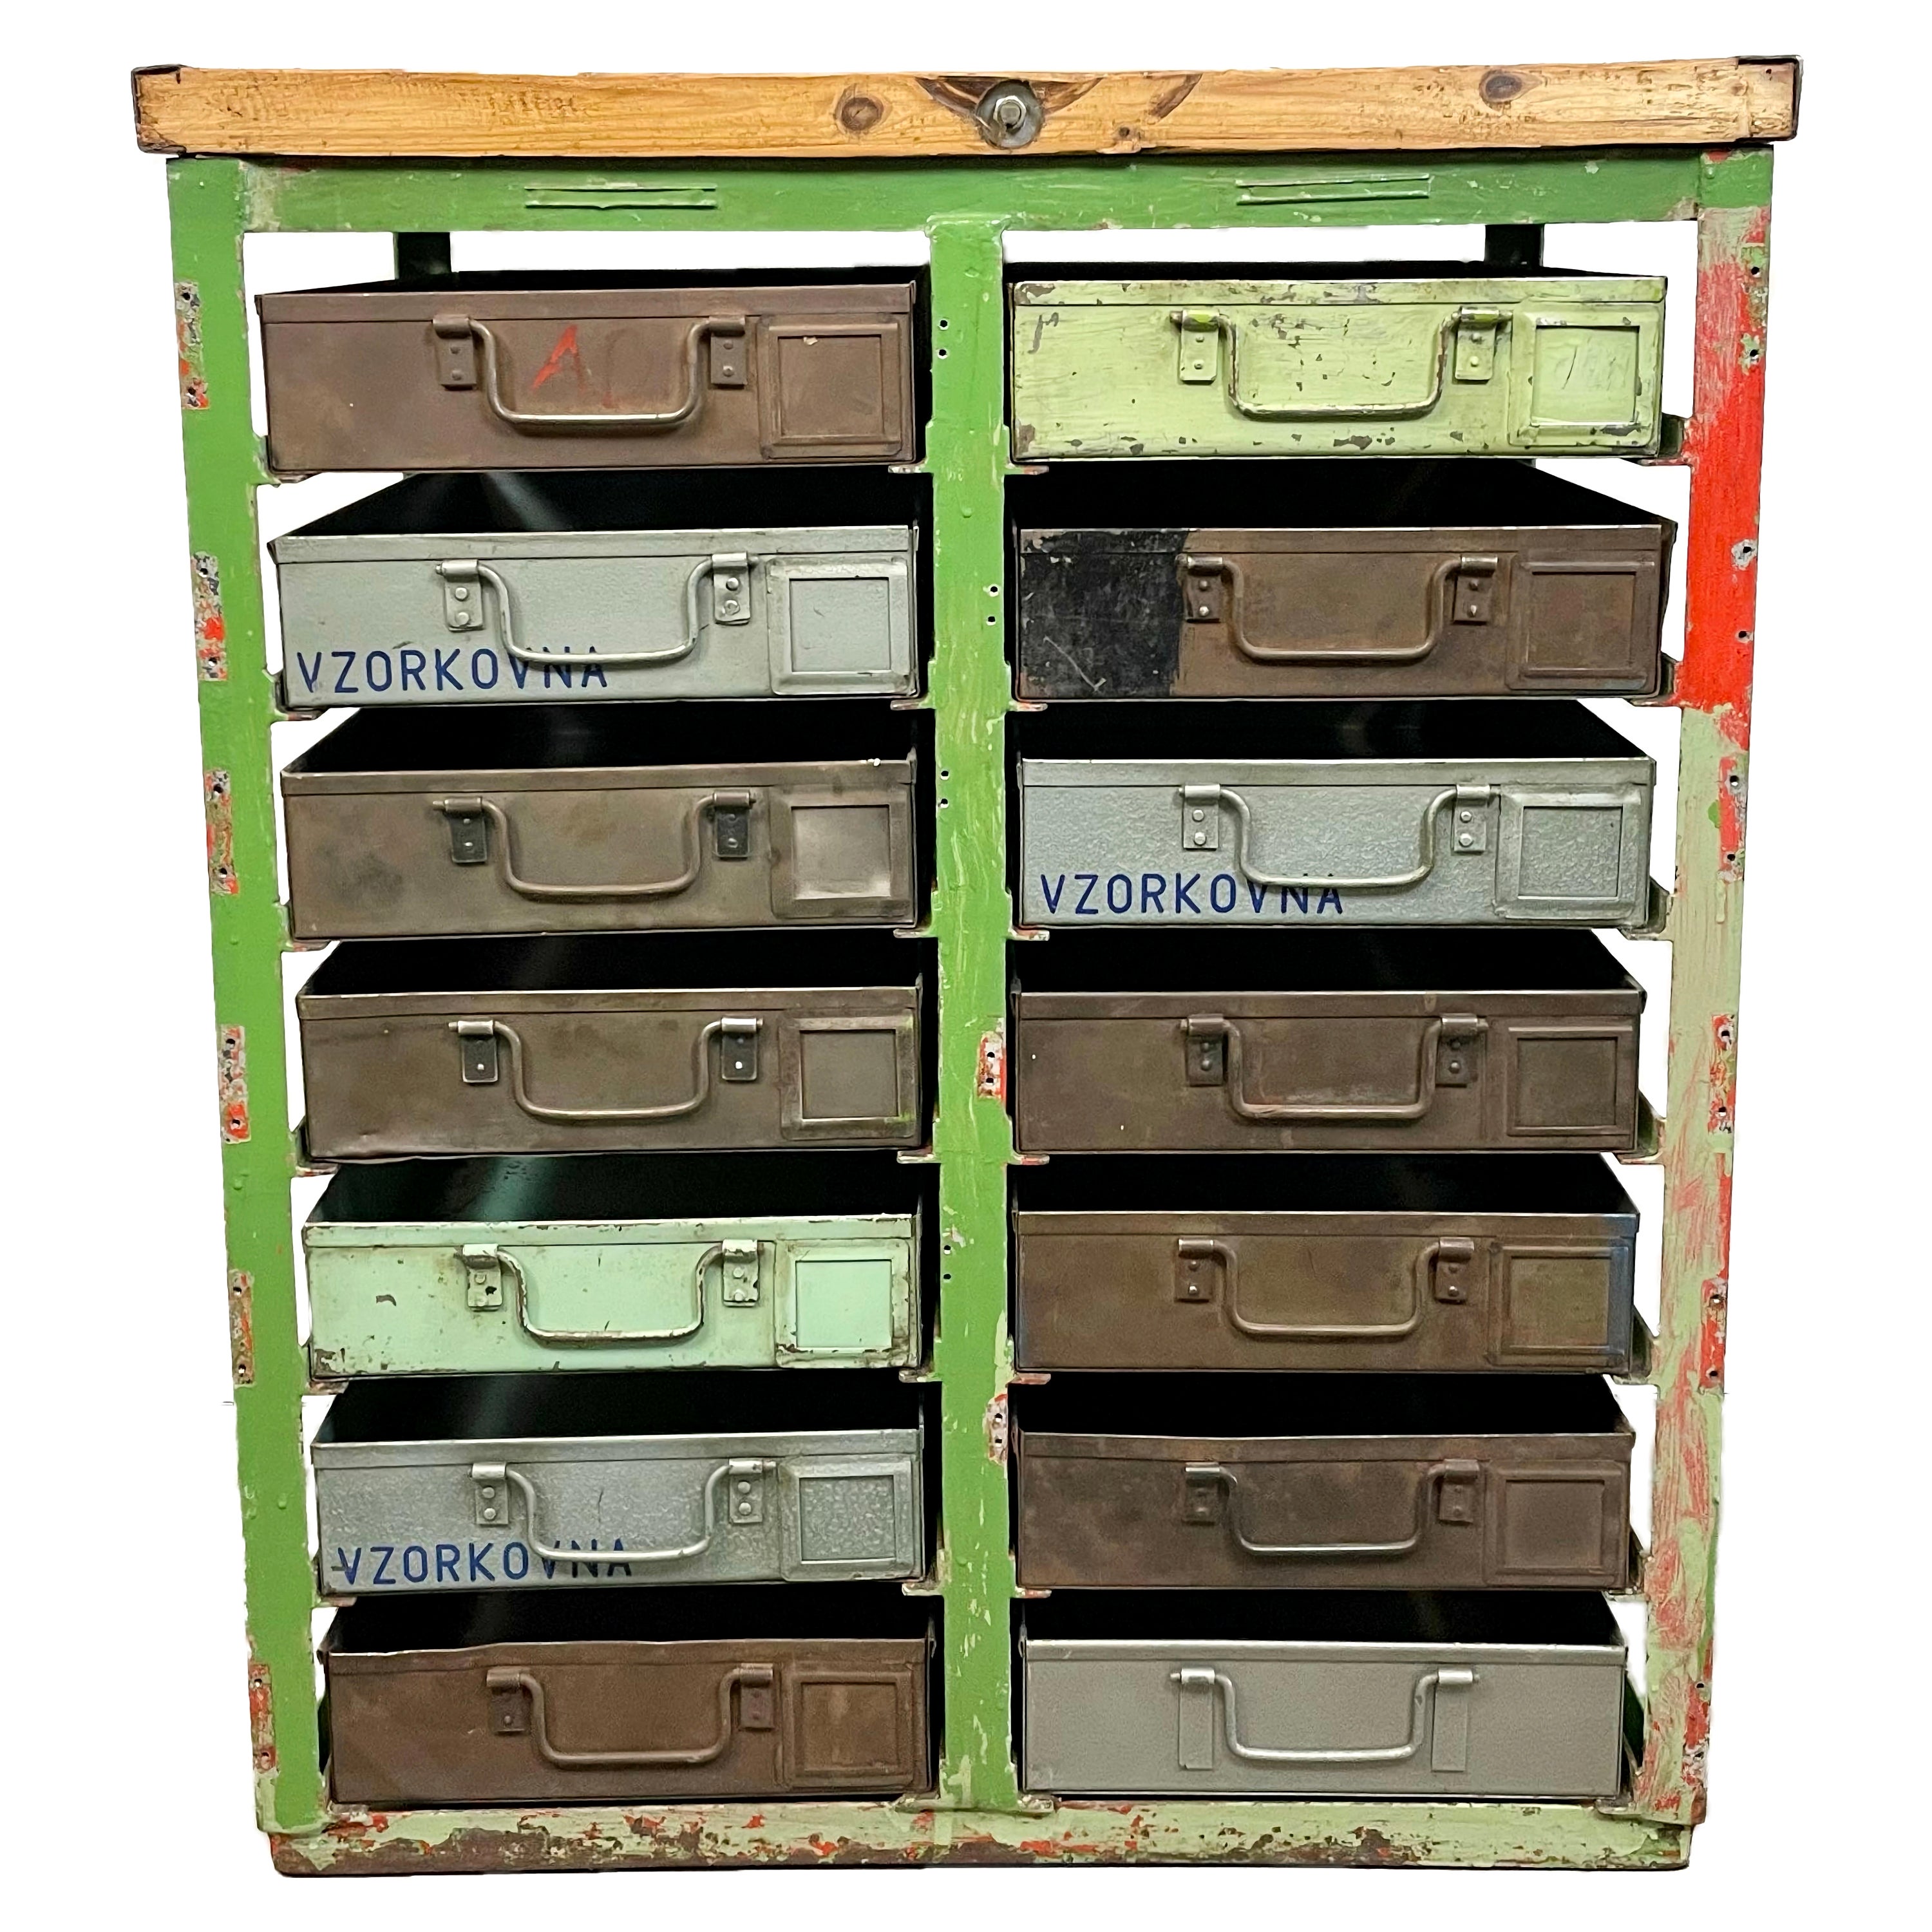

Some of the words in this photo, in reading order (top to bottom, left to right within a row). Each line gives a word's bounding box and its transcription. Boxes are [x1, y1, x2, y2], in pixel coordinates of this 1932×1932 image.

[297, 646, 608, 693] VZORKOVNA
[1040, 873, 1343, 914] VZORKOVNA
[337, 1538, 632, 1586] VZORKOVNA
